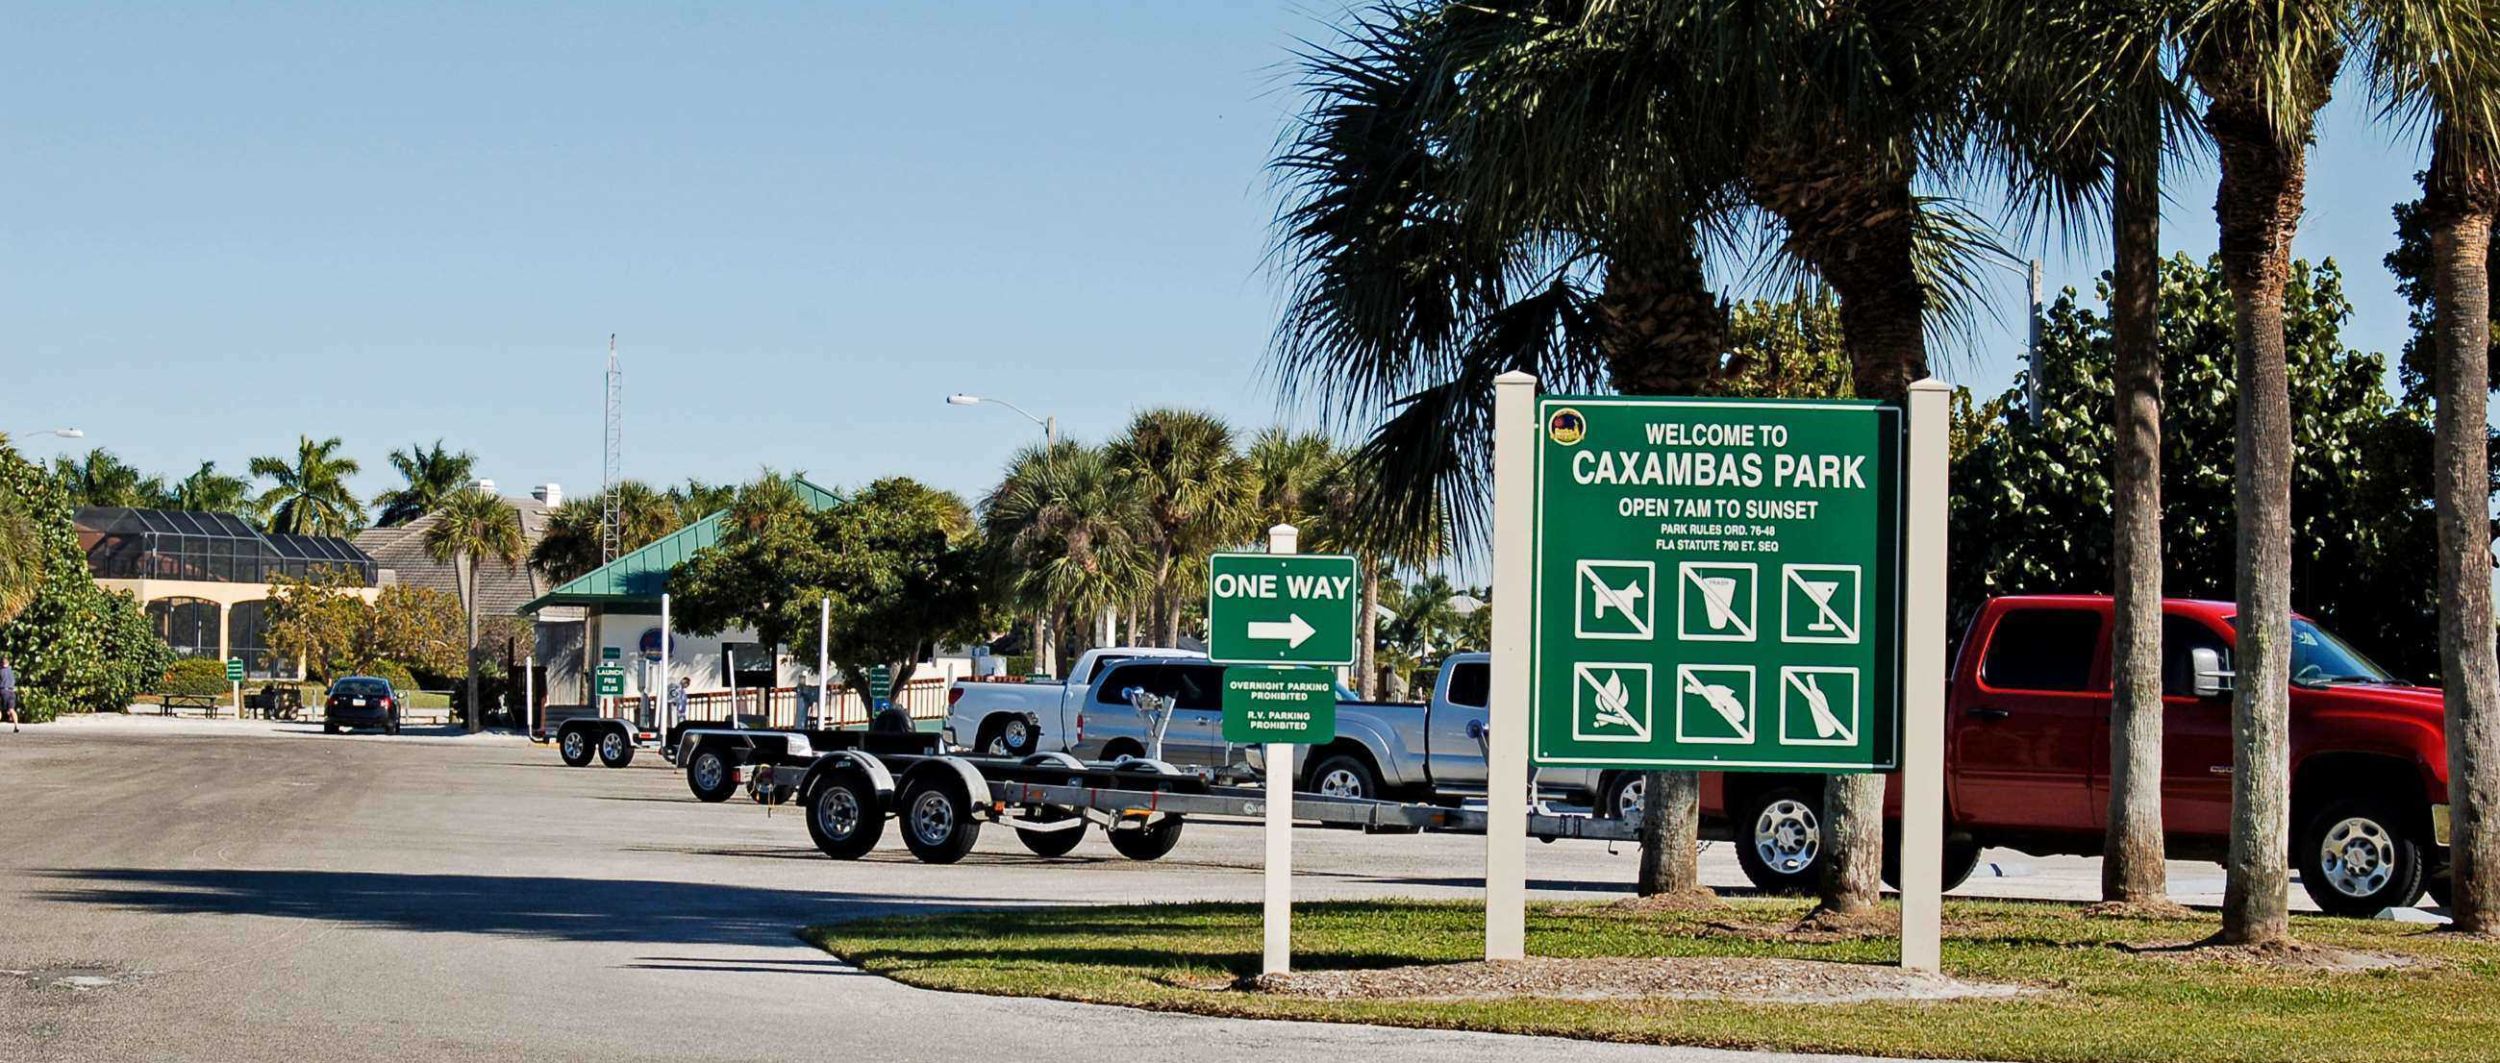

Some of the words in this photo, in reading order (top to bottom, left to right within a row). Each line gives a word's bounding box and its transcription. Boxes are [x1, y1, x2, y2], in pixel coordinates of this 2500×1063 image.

[1646, 424, 1754, 446] WELCOME
[1759, 425, 1787, 447] TO
[1573, 450, 1762, 487] CAXAMBAS
[1775, 454, 1865, 488] PARK
[1619, 498, 1668, 516] OPEN
[1674, 499, 1711, 517] 7AM
[1715, 500, 1740, 518] TO
[1746, 500, 1818, 519] SUNSET
[1661, 524, 1687, 535] PARK
[1690, 524, 1721, 535] RULES
[1724, 525, 1747, 535] ORD.
[1656, 539, 1675, 550] FLA
[1678, 540, 1720, 551] STATUTE
[1723, 541, 1739, 551] 790
[1741, 541, 1755, 551] ET.
[1758, 541, 1779, 552] SEQ
[1215, 574, 1277, 598] ONE
[1286, 576, 1350, 599] WAY
[1230, 682, 1284, 691] OVERNIGHT
[1287, 682, 1329, 692] PARKING
[1251, 692, 1308, 701] PROHIBITED
[1247, 711, 1266, 720] R.V.
[1269, 711, 1311, 721] PARKING
[1250, 721, 1307, 730] PROHIBITED
